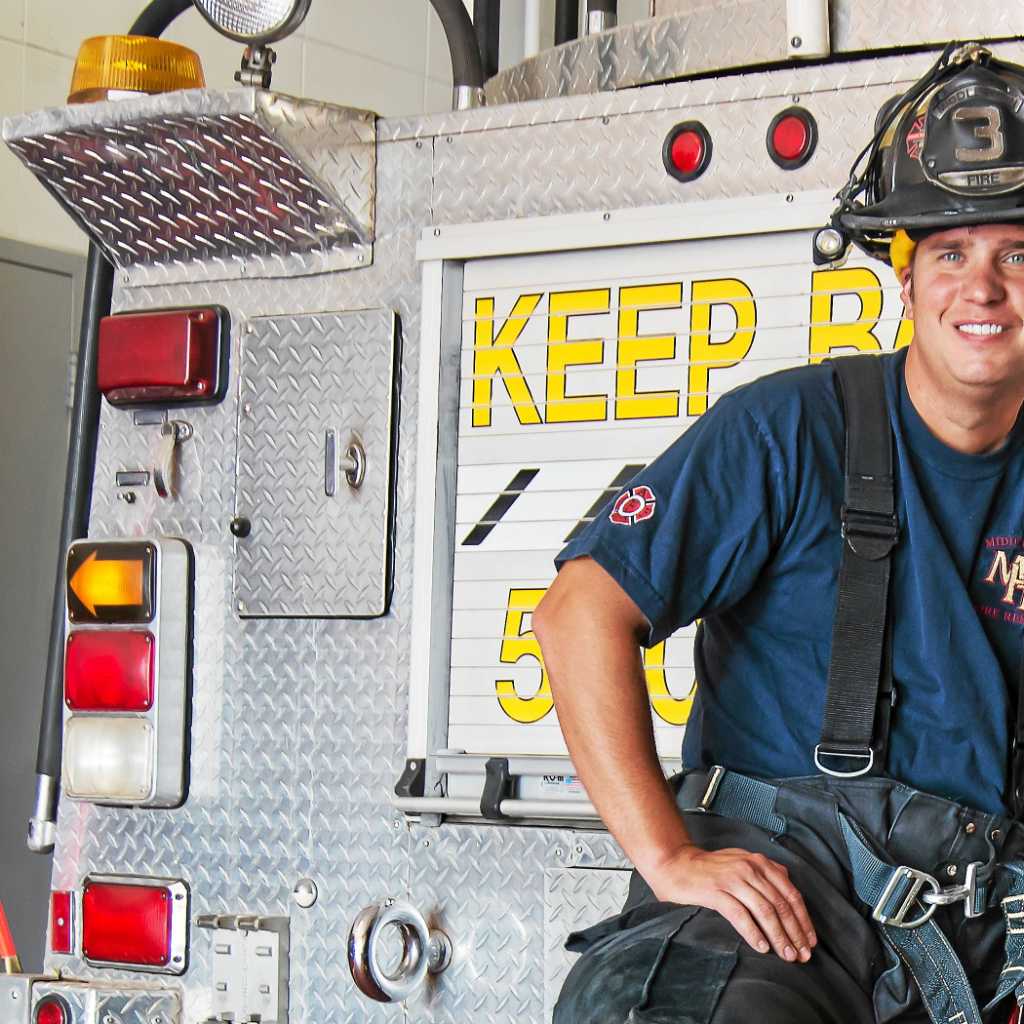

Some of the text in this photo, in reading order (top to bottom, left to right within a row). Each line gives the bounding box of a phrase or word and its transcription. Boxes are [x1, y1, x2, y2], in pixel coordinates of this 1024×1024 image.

[953, 105, 1004, 162] 3
[967, 174, 999, 187] FIRE
[472, 277, 758, 428] KEEP
